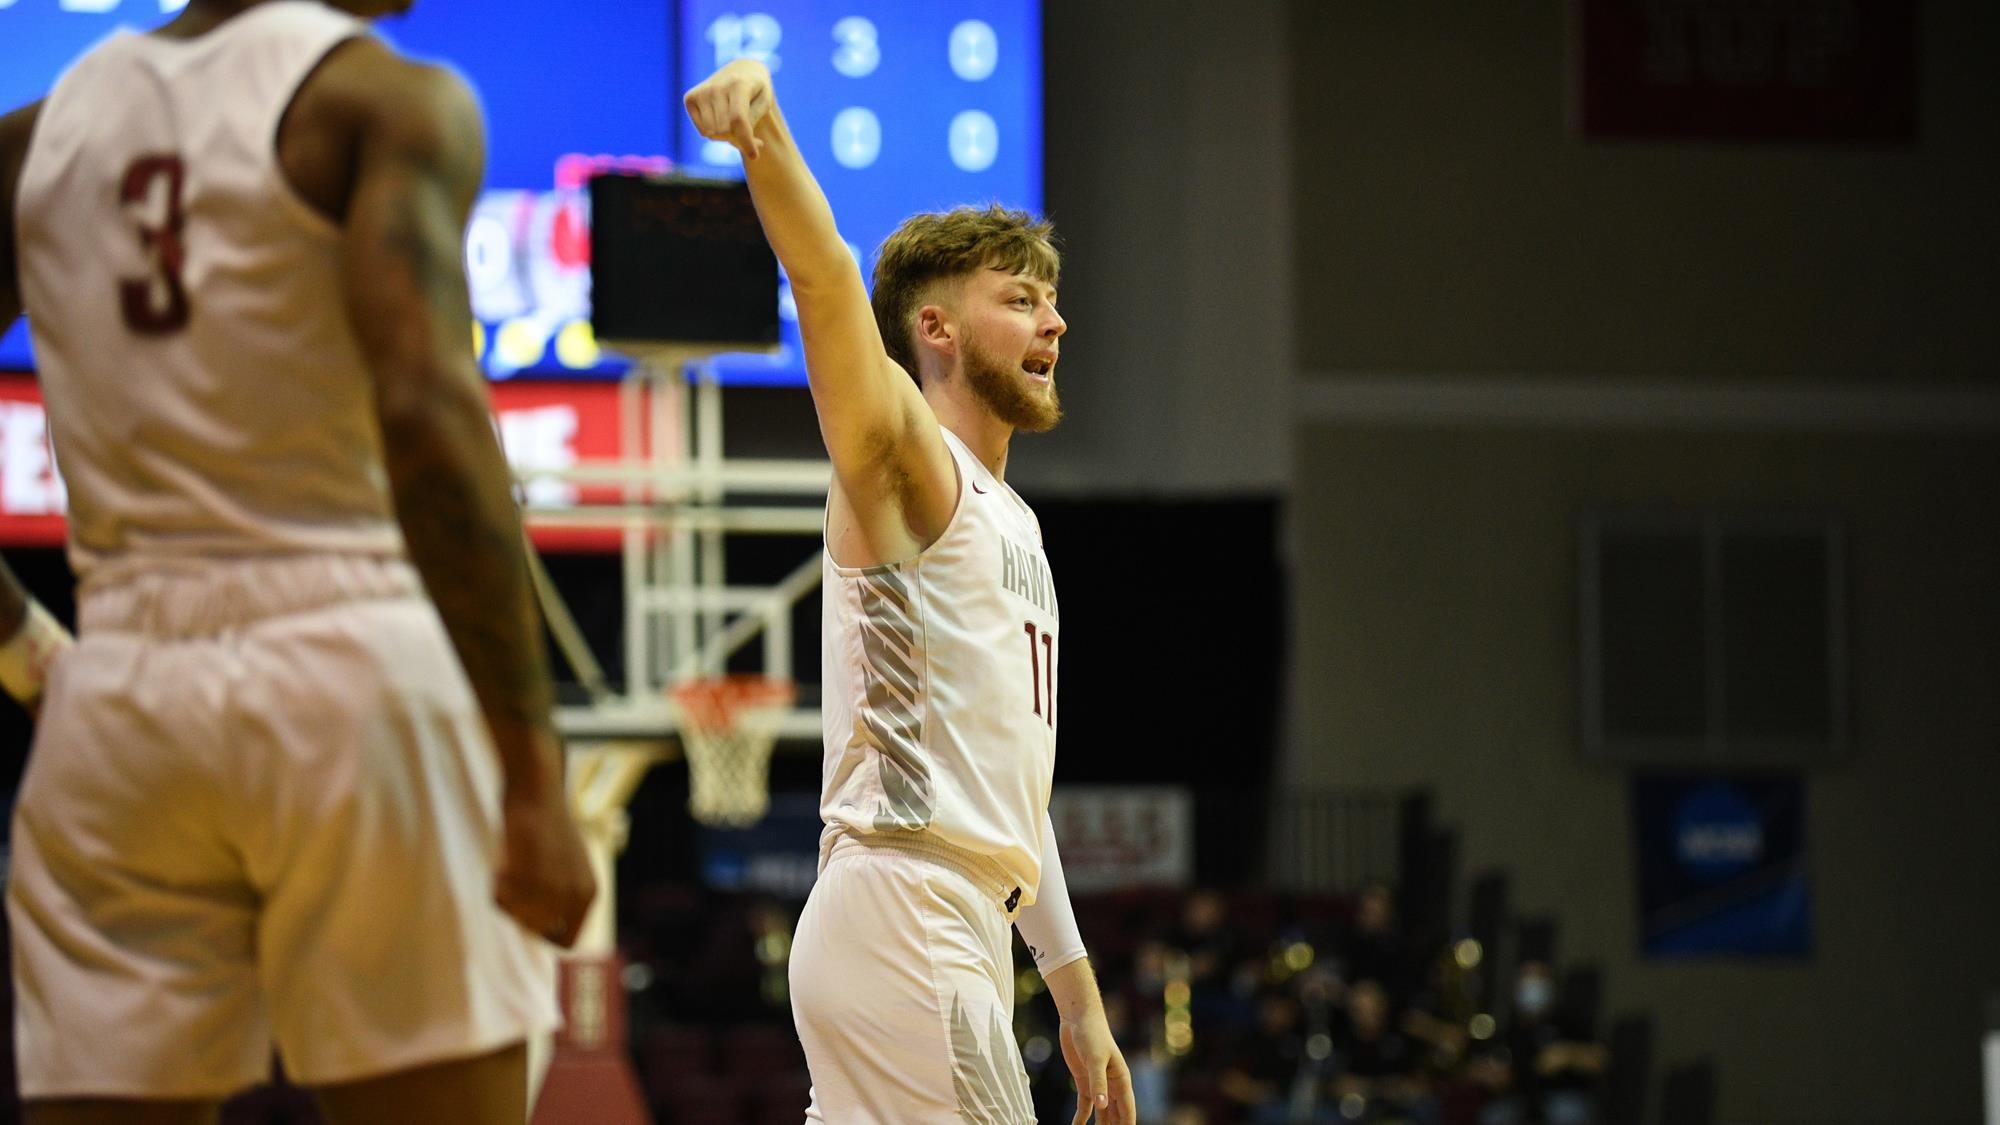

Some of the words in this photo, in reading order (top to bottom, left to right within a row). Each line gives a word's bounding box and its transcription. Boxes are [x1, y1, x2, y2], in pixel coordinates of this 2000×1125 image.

[706, 12, 781, 72] 12
[832, 15, 880, 78] 3
[948, 19, 998, 81] 0
[831, 106, 881, 169] 0
[949, 109, 998, 172] 0
[119, 154, 191, 338] 3
[1024, 620, 1053, 729] 11
